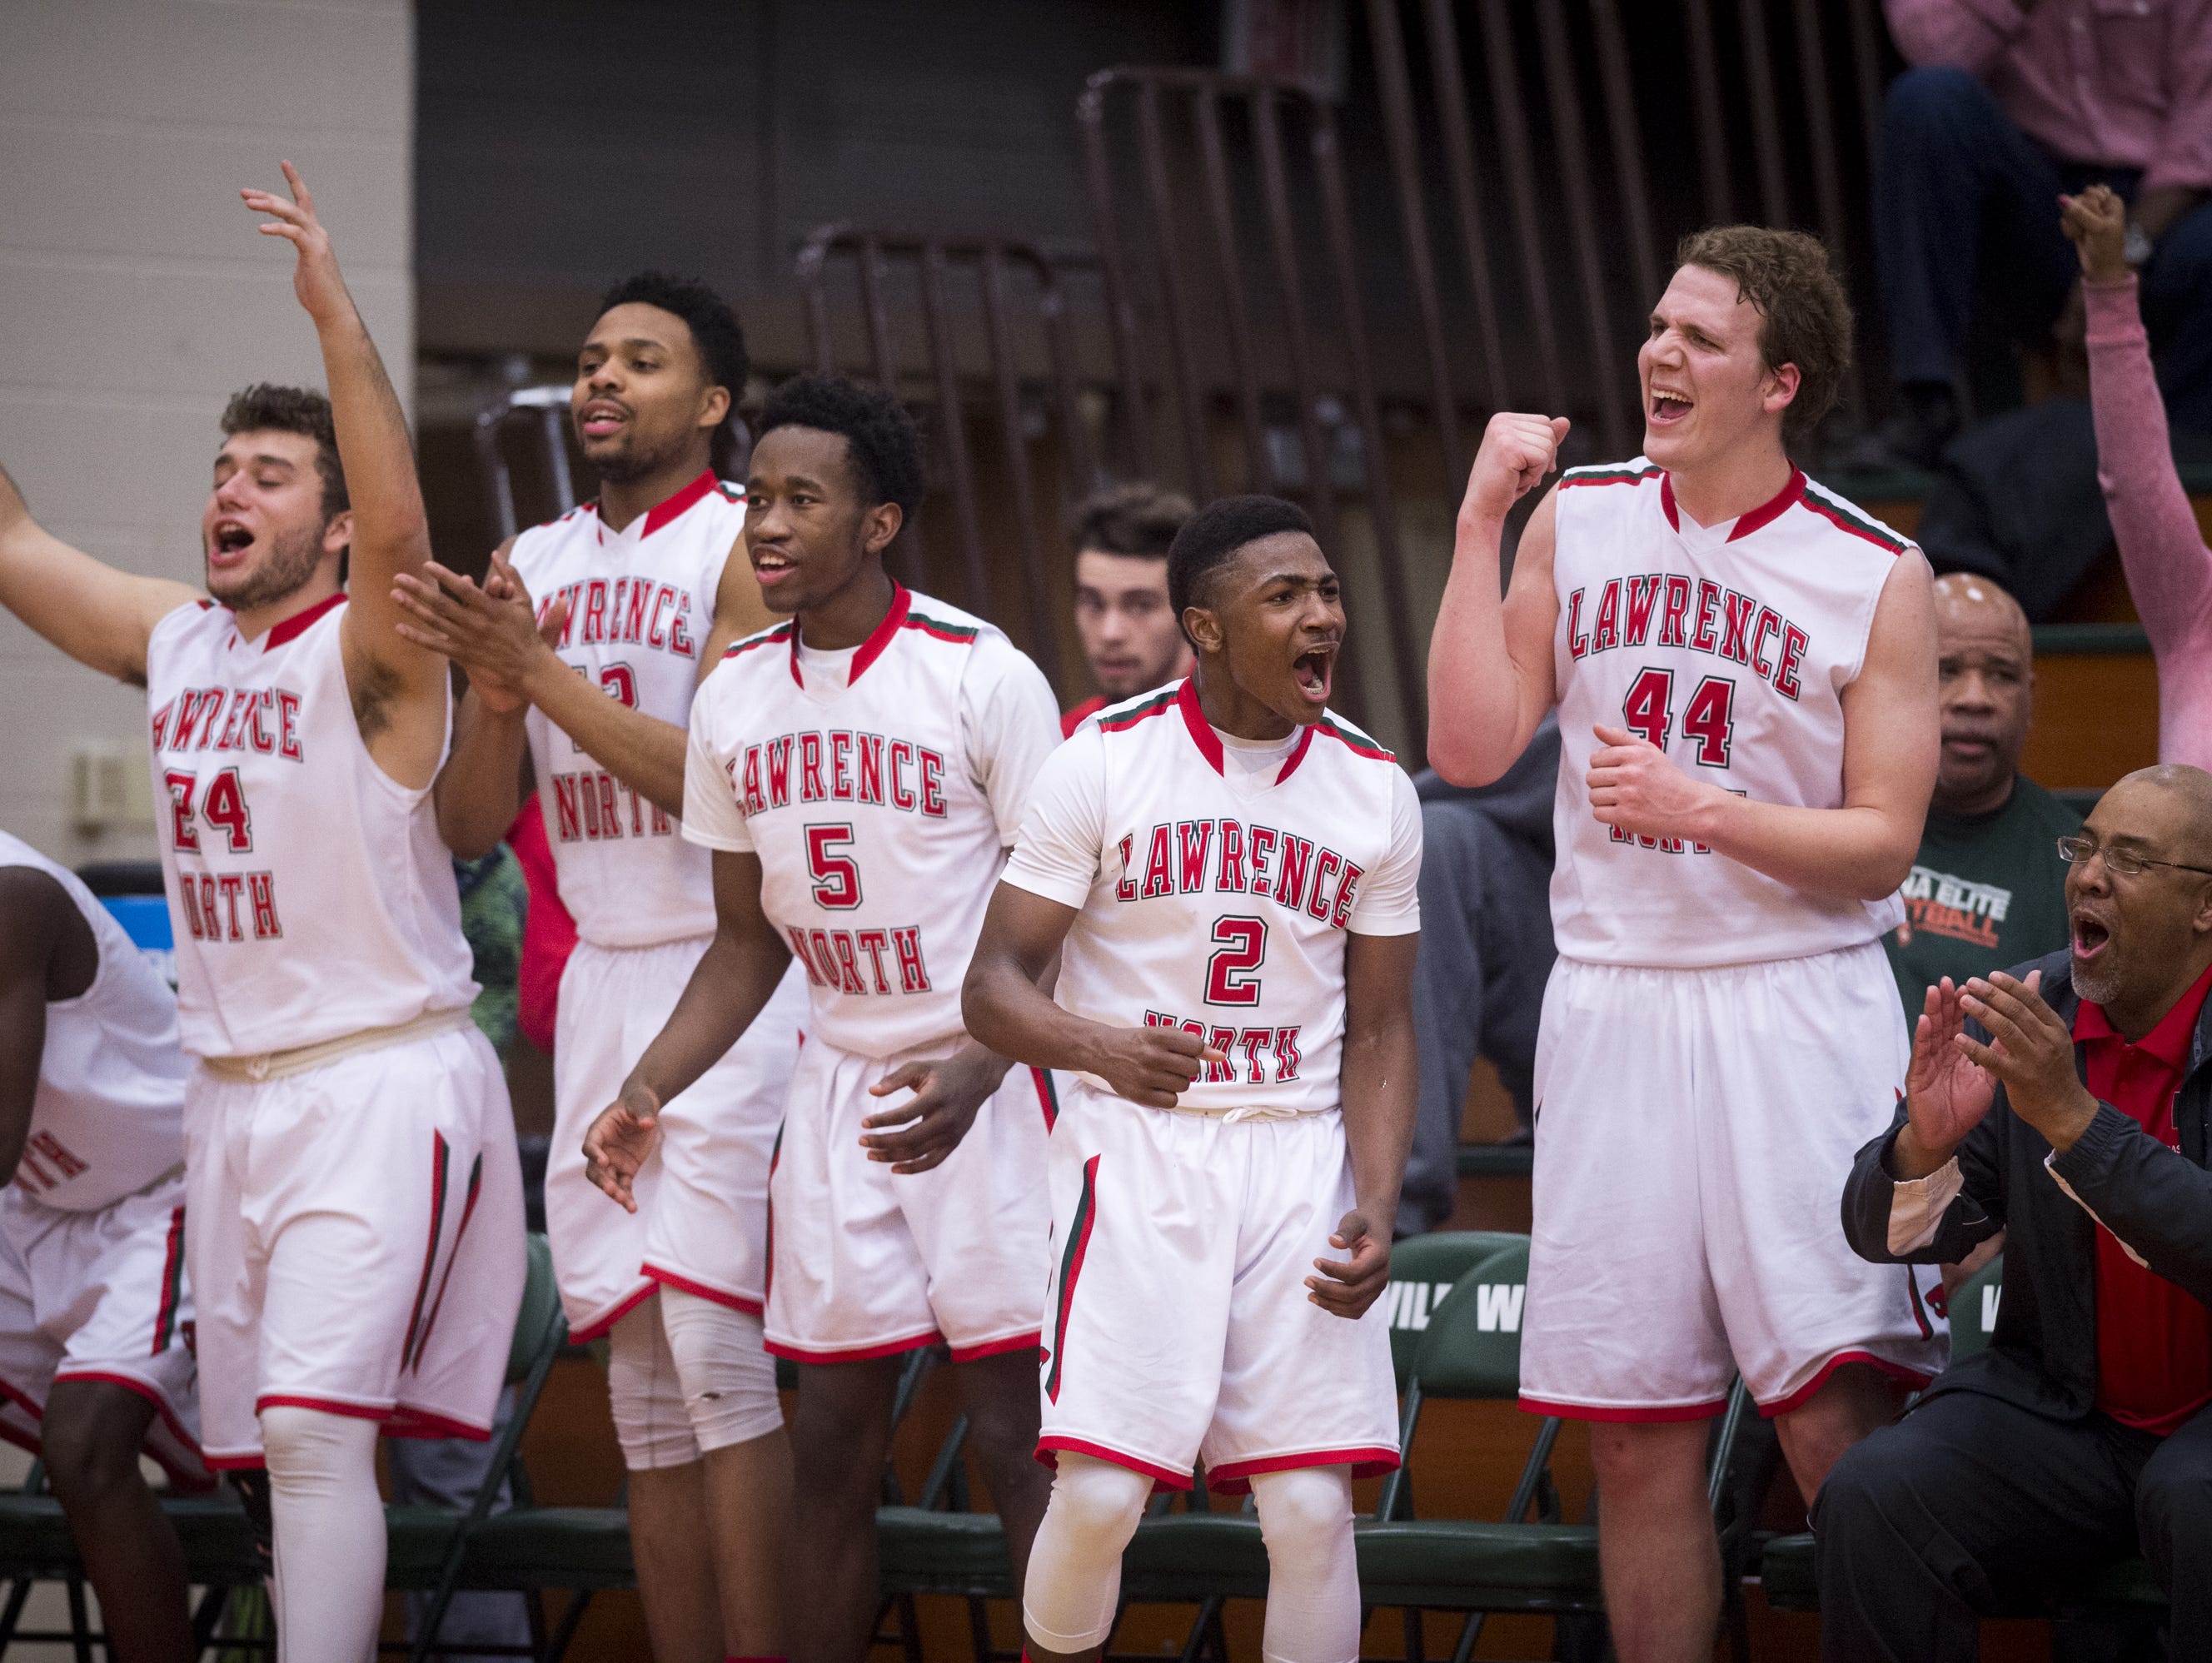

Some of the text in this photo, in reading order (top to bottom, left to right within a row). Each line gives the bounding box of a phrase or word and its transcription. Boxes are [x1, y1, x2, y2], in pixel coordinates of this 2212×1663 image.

[536, 576, 695, 660] WRENCE
[1567, 574, 1810, 701] LAWRENCE
[1622, 666, 1736, 769] 44
[165, 765, 252, 854] 24
[803, 822, 863, 910] 5
[1116, 819, 1364, 929] LAWRENCE
[1935, 874, 2012, 922] ELITE
[785, 925, 932, 995] NORTH
[1203, 914, 1268, 1007] 2
[1903, 894, 1999, 949] TBALL
